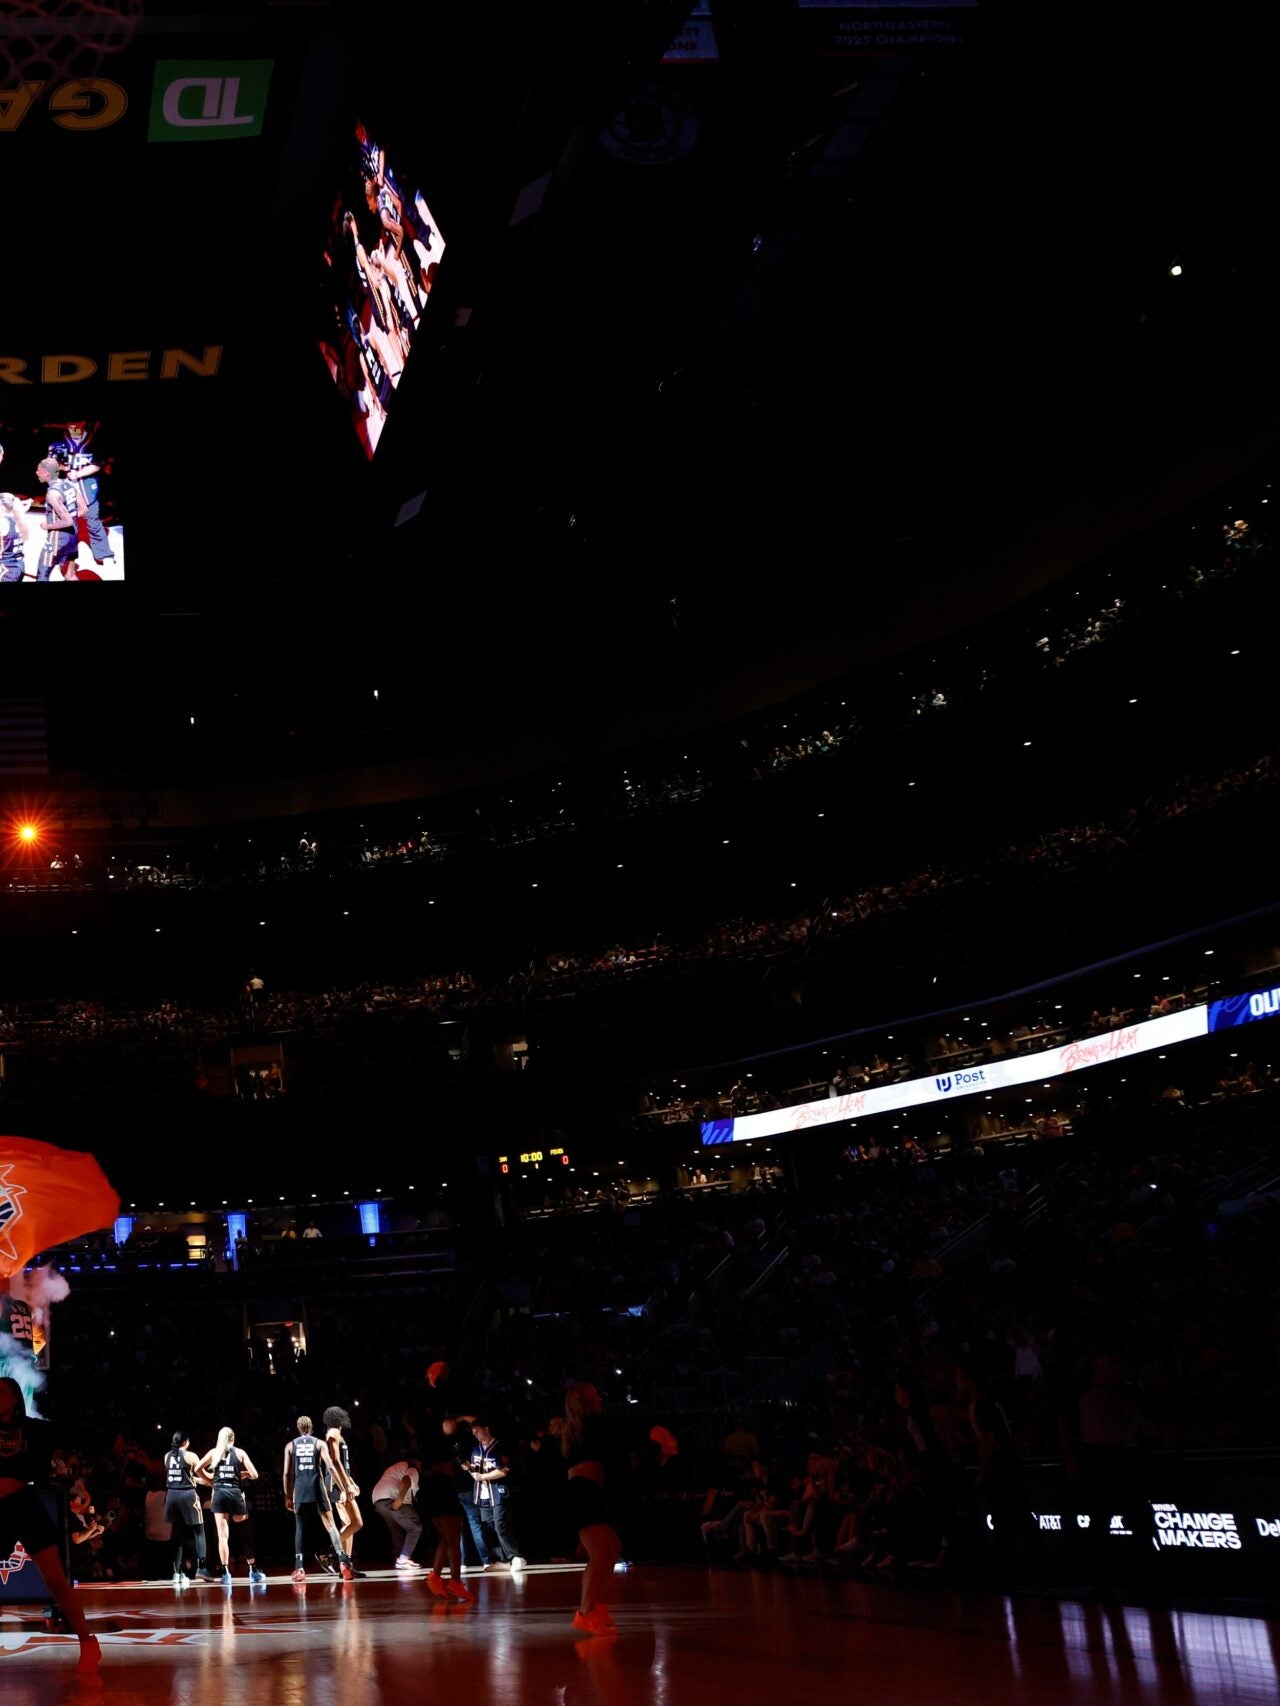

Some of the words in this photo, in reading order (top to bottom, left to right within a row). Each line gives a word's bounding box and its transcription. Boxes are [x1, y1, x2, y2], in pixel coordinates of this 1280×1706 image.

[162, 76, 255, 128] TD
[954, 1069, 985, 1085] Post
[502, 1164, 509, 1174] 0
[562, 1155, 569, 1165] 0
[520, 1151, 543, 1163] 10:00
[9, 1313, 33, 1341] 25
[296, 1443, 315, 1457] 22
[1039, 1515, 1062, 1530] AT&T
[1154, 1511, 1238, 1531] CHANGE
[1158, 1530, 1242, 1550] MAKERS
